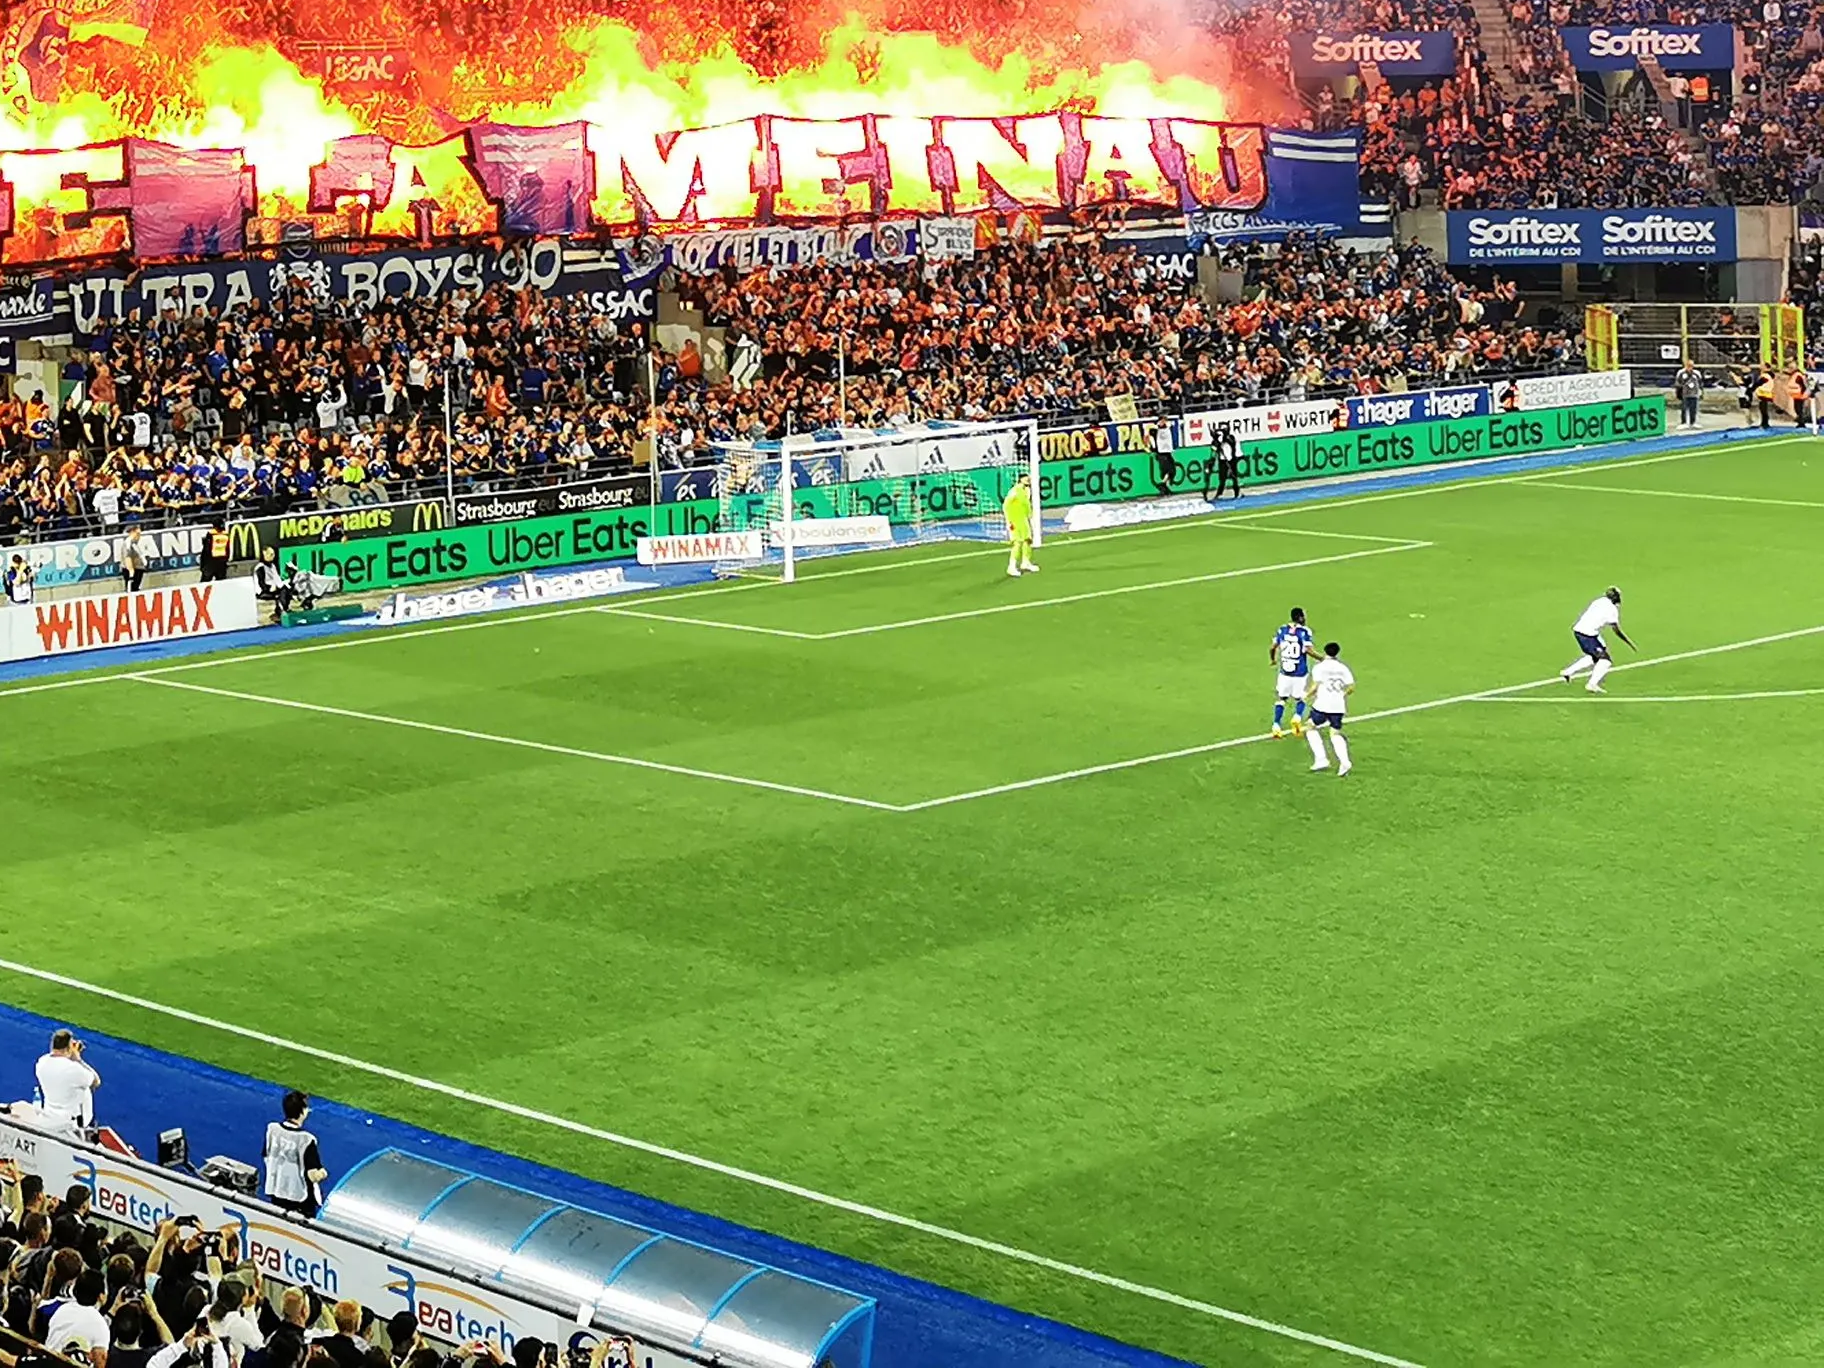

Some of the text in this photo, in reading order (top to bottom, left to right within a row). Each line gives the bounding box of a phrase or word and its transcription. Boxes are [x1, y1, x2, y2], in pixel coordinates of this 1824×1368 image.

[1312, 33, 1423, 62] Sofitex
[1589, 27, 1702, 57] Sofitex
[584, 113, 1268, 229] MEINAU
[1468, 216, 1581, 246] Sofitex
[1602, 214, 1716, 244] Sofitex
[1428, 418, 1543, 457] Uber Eats
[1556, 404, 1659, 443] Uber Eats
[1293, 433, 1415, 473] Uber Eats
[1068, 461, 1133, 497] Eats
[386, 538, 467, 579] Eats
[489, 516, 648, 567] Uber Eats
[649, 535, 750, 562] WINAMAX
[35, 584, 214, 652] WINAMAX
